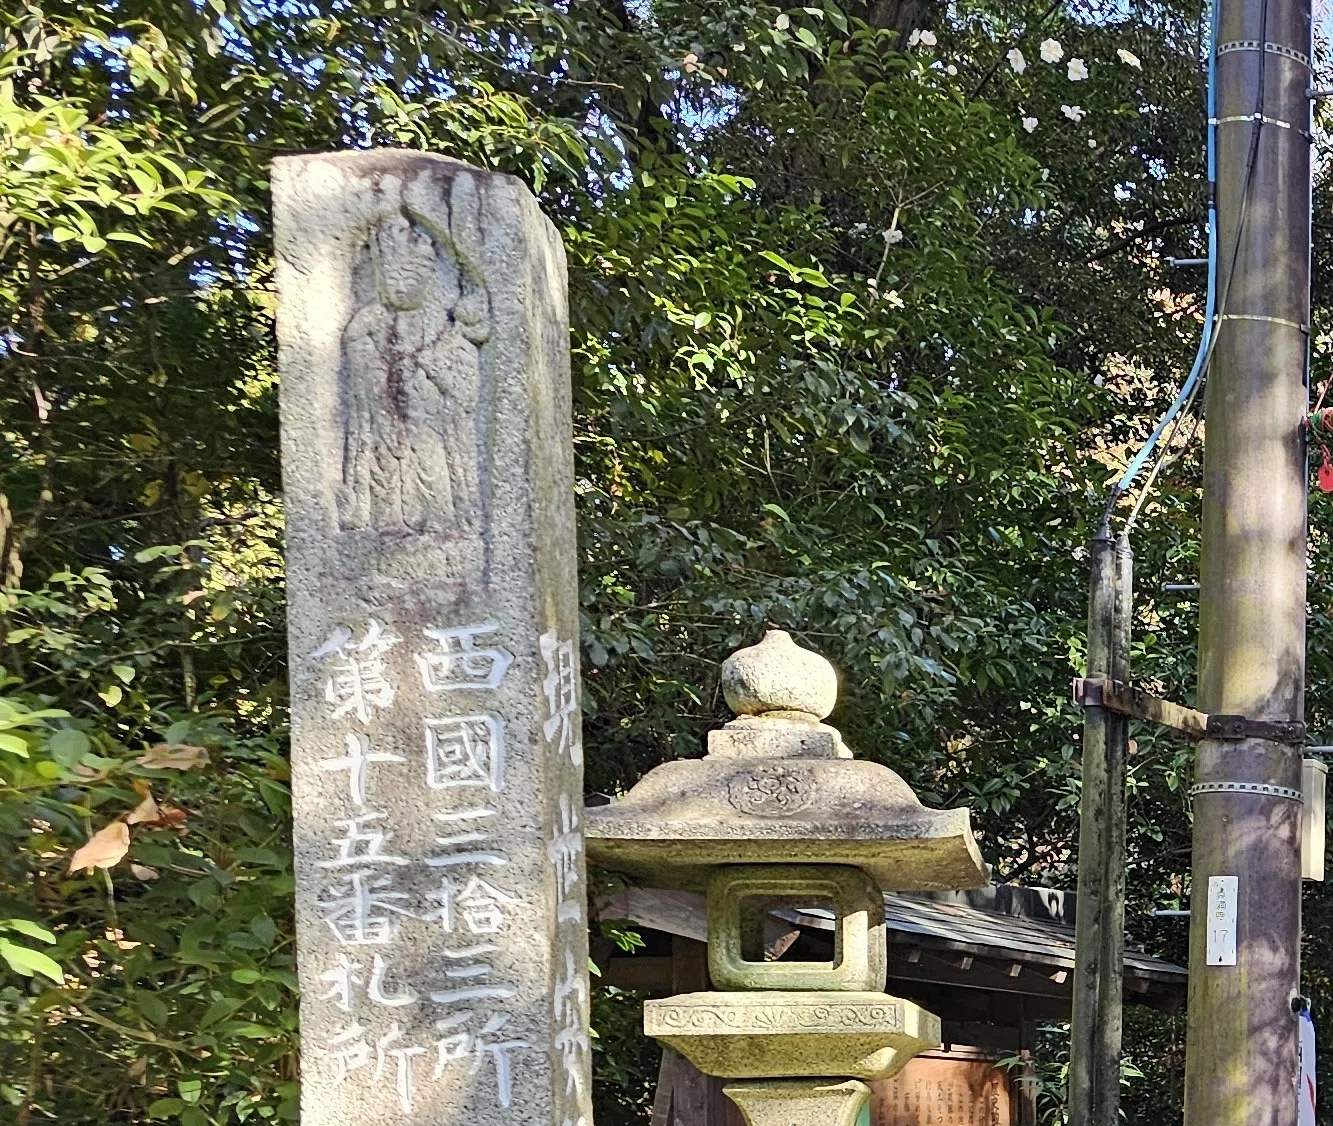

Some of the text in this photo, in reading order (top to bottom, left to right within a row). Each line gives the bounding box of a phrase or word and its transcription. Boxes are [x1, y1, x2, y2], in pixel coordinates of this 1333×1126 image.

[312, 626, 426, 1111] 第十五番札所
[415, 622, 532, 1108] 西國三拾三所
[1213, 929, 1229, 945] 17
